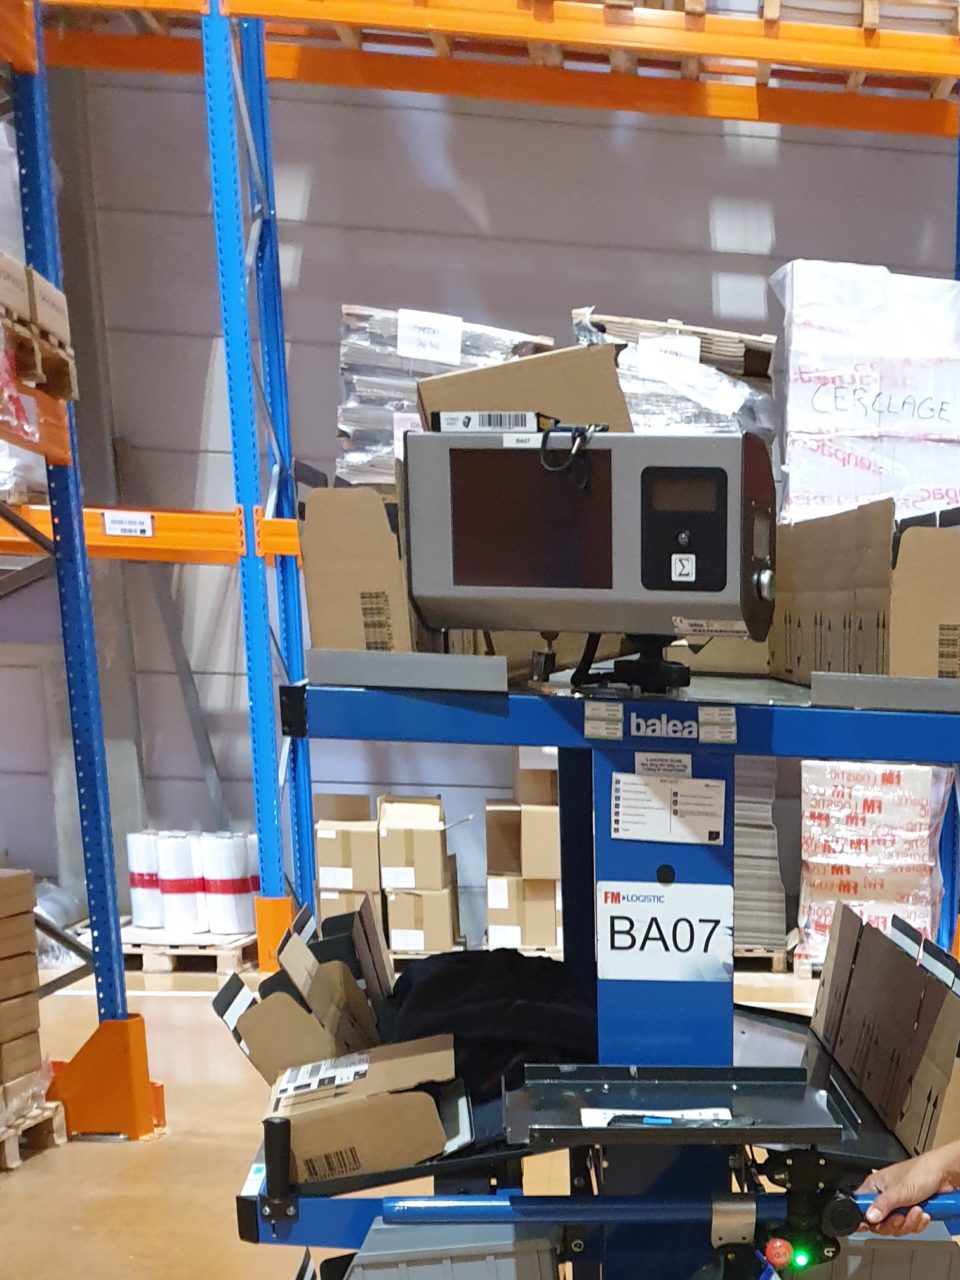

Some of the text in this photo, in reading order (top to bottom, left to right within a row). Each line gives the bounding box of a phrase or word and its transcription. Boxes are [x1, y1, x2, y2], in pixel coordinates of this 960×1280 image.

[811, 384, 952, 423] CERCLAGE
[630, 712, 698, 738] balea
[604, 891, 665, 904] FM LOGISTIC
[609, 915, 721, 953] BA07
